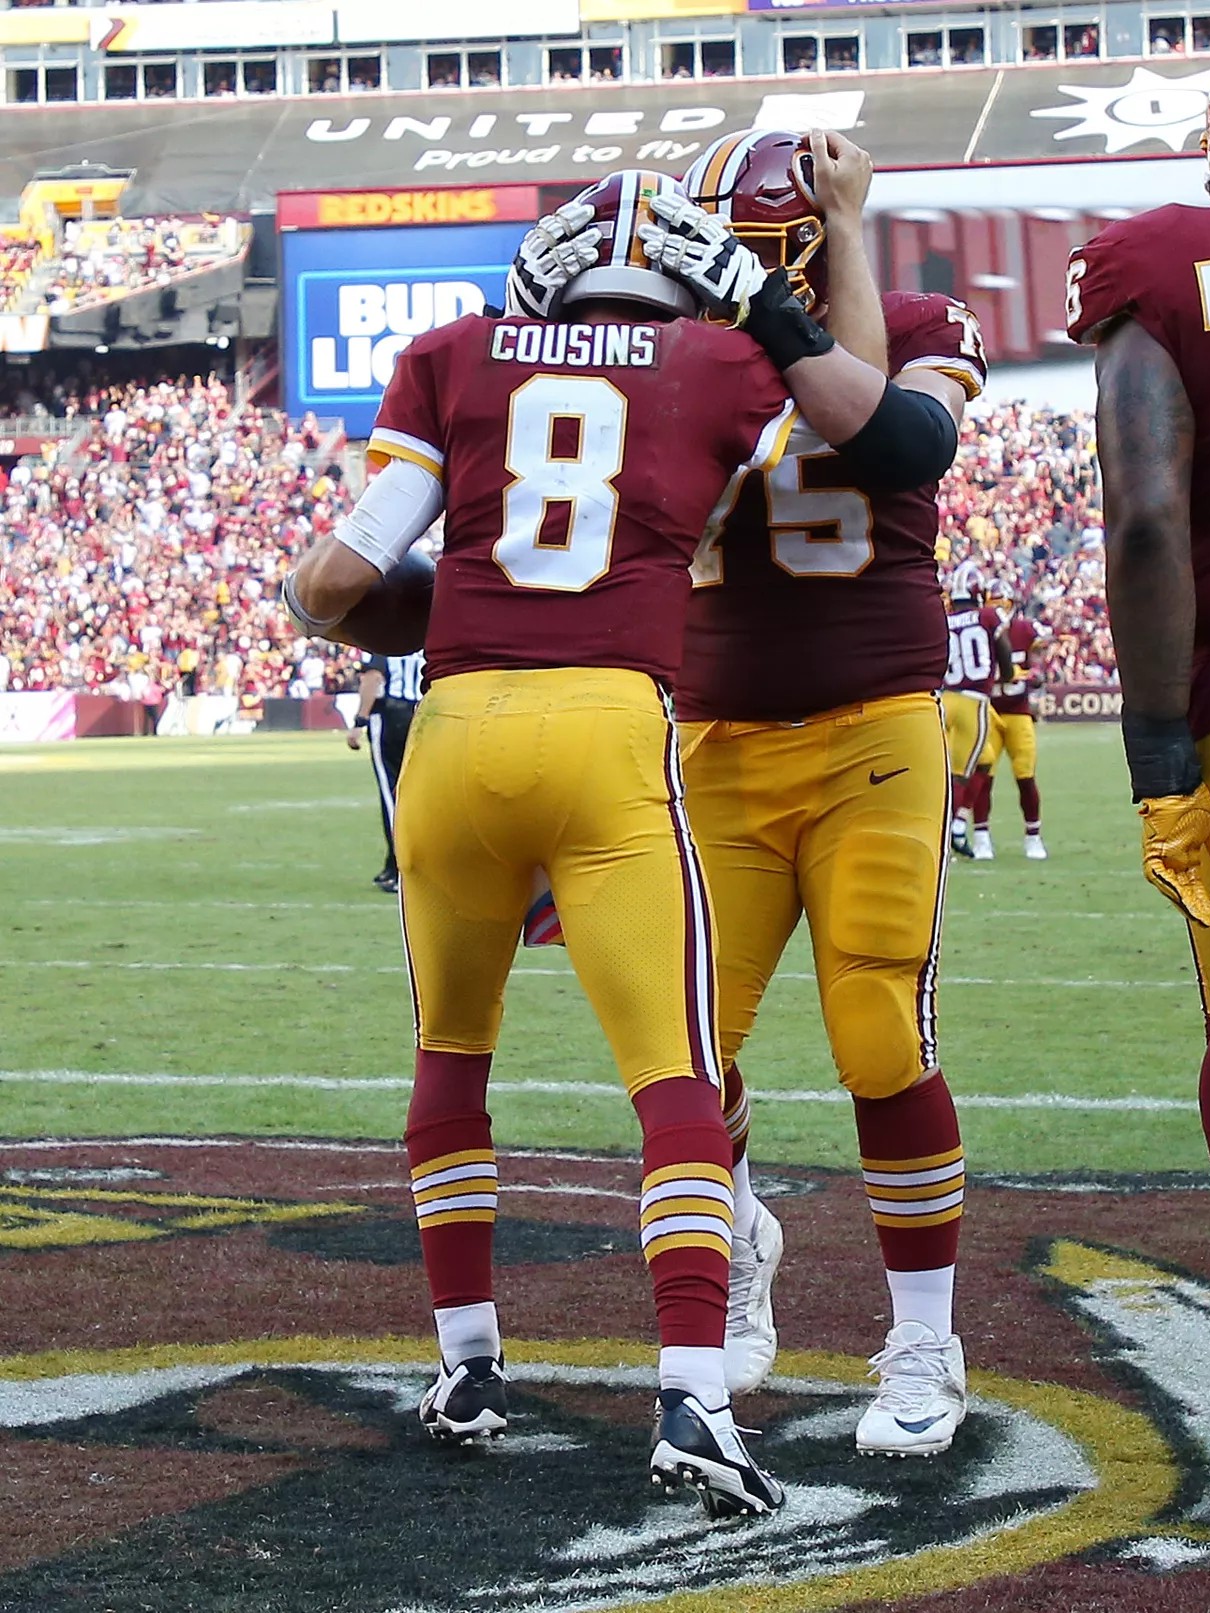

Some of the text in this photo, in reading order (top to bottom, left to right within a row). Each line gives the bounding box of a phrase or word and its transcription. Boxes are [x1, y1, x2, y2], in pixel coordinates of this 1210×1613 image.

[306, 108, 726, 142] UNITED
[413, 139, 701, 171] Proud to fly
[318, 189, 497, 225] REDSKINS
[338, 281, 486, 337] BUD
[490, 323, 656, 367] COUSINS
[491, 372, 629, 593] 8
